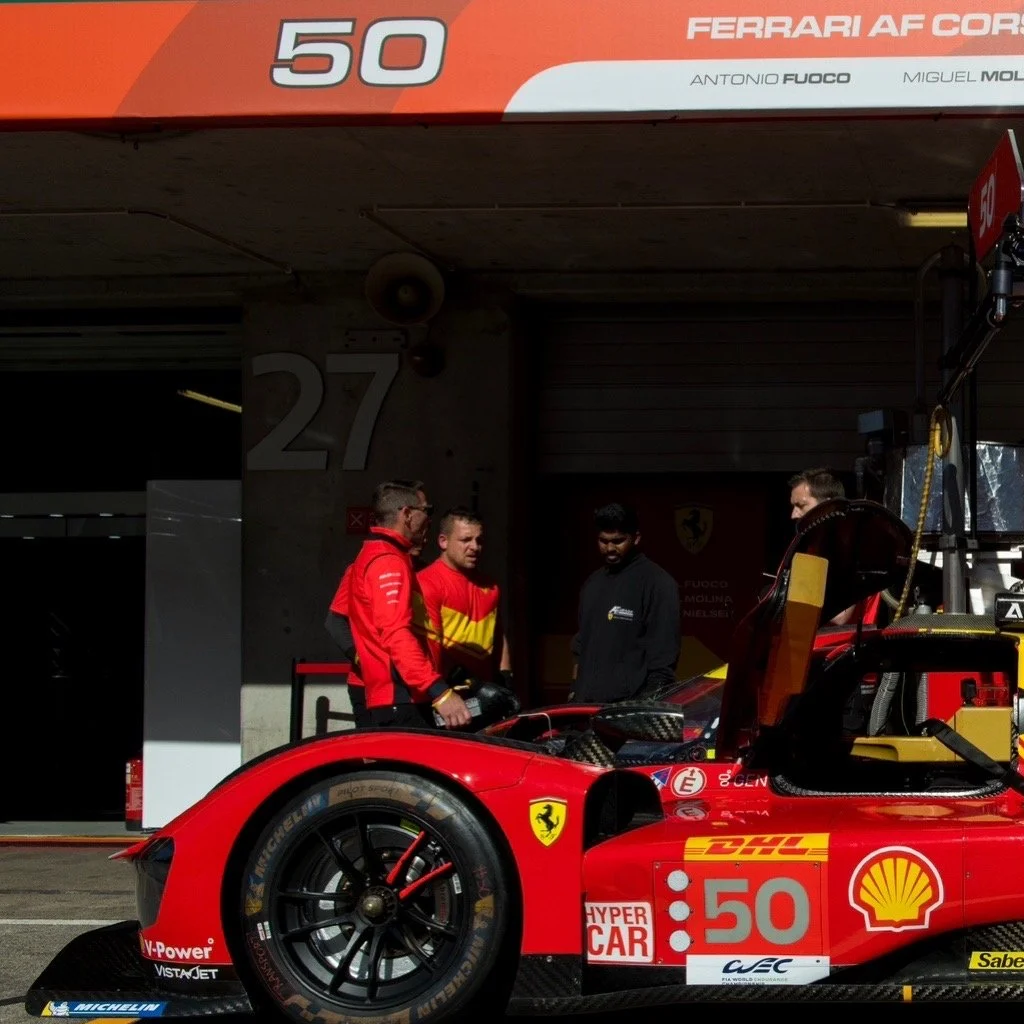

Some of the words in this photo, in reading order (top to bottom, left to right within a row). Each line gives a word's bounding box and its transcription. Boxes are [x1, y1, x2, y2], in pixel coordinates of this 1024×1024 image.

[686, 13, 861, 40] FERRARI
[867, 13, 925, 39] AF
[270, 16, 447, 88] 50
[689, 72, 779, 86] ANTONIO
[782, 72, 852, 85] FUOCO
[902, 70, 977, 84] MIGUEL
[979, 173, 995, 238] 50
[246, 352, 399, 470] 27
[704, 836, 810, 855] DHL
[587, 906, 647, 925] HYPER
[704, 877, 810, 945] 50
[144, 938, 214, 959] V-Power
[588, 924, 648, 957] CAR
[722, 957, 793, 974] WEC
[74, 1003, 160, 1012] MICHELIN
